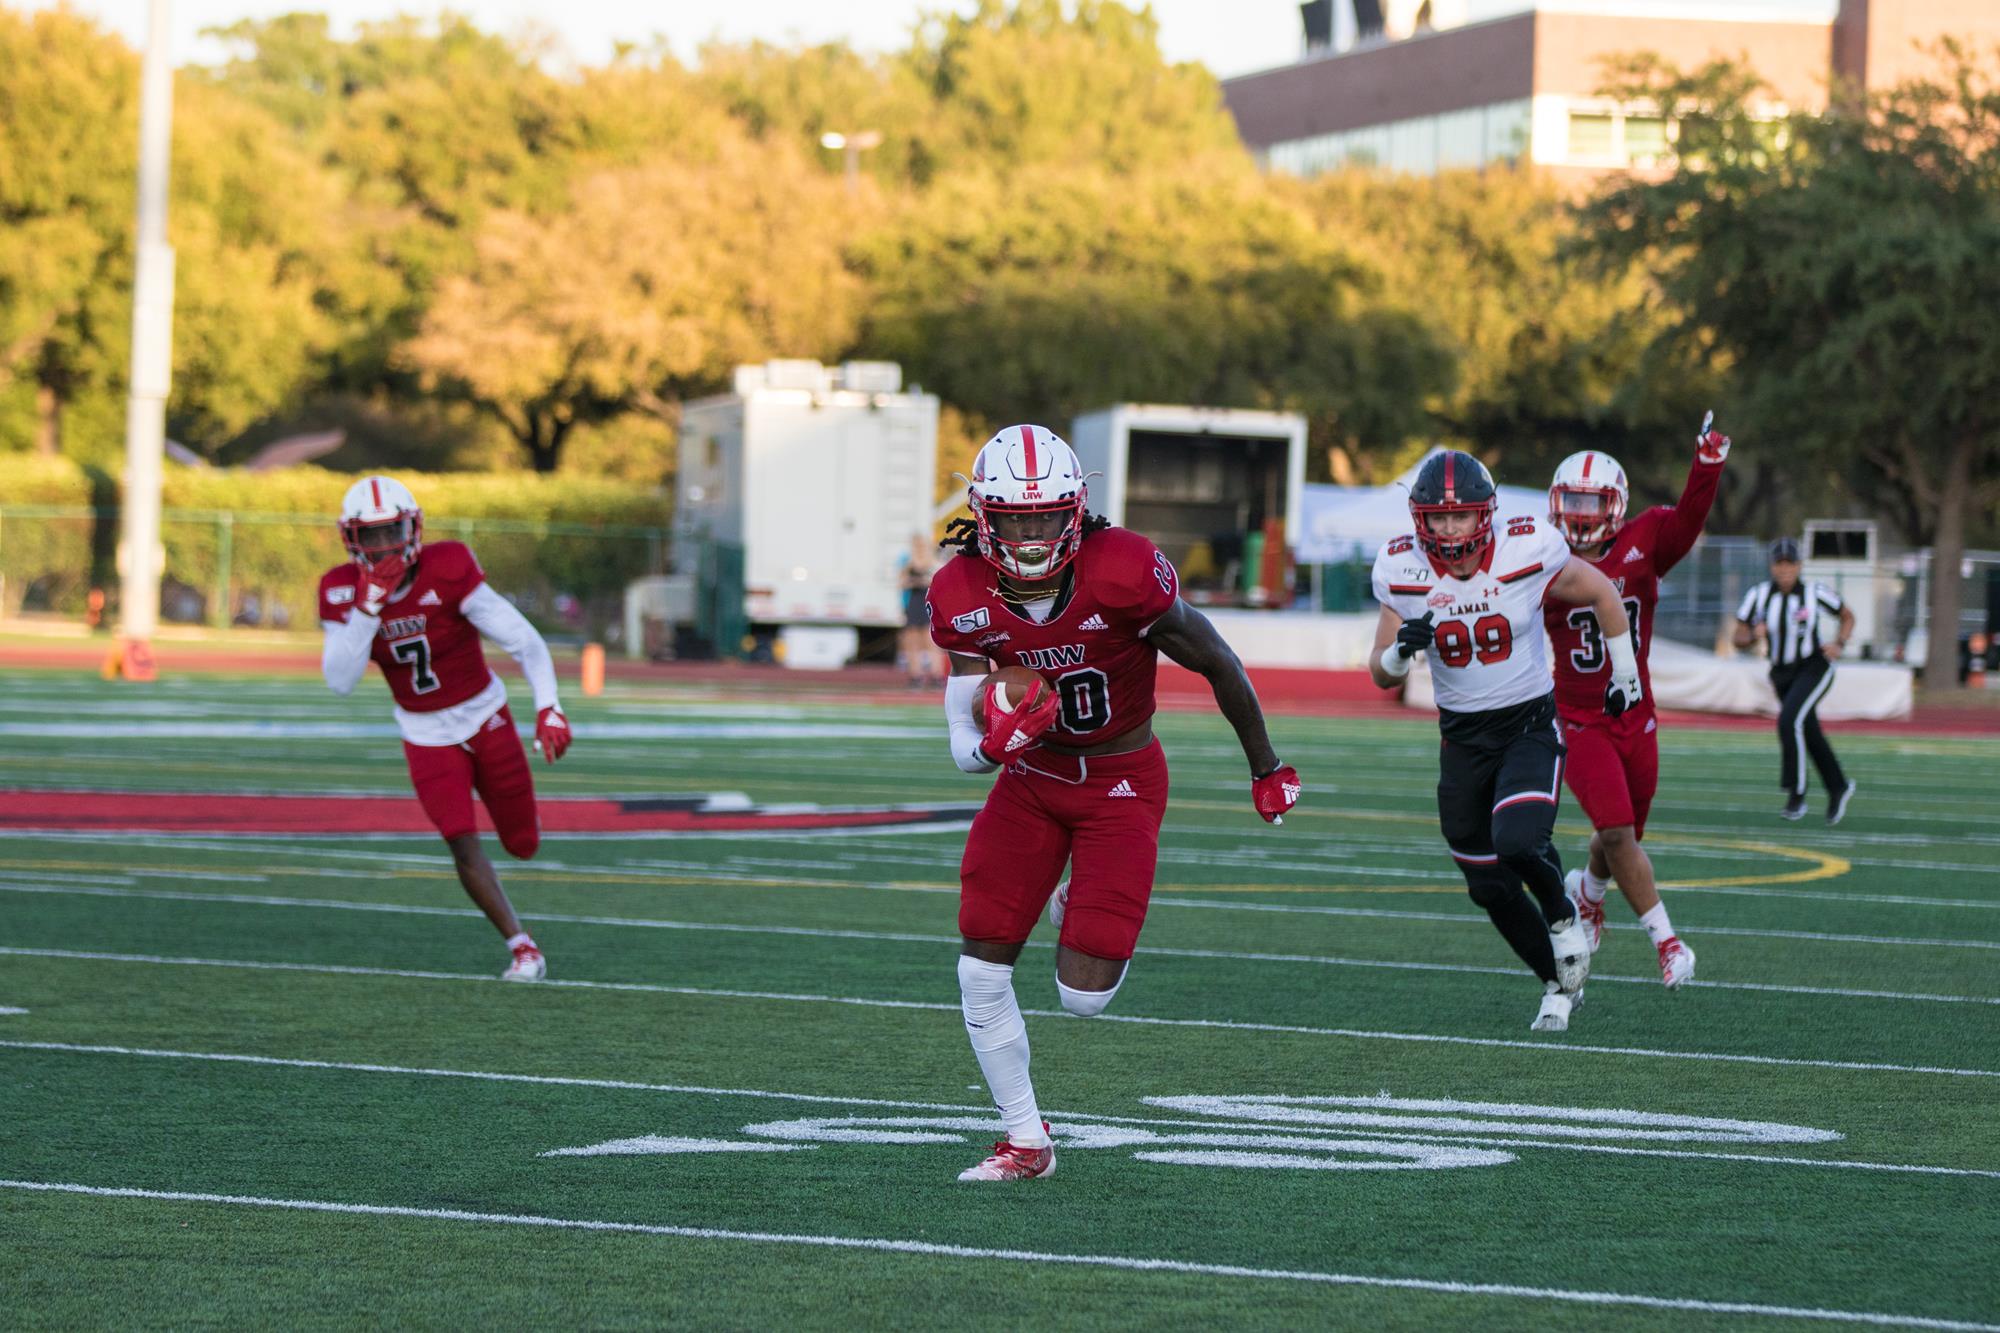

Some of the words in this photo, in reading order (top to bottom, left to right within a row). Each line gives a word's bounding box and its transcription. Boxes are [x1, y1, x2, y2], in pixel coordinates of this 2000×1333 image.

[1022, 491, 1043, 500] UIW
[951, 607, 990, 633] 150
[1449, 602, 1490, 617] LAMAR
[379, 614, 426, 641] UIW
[1078, 623, 1109, 631] adidas
[390, 634, 441, 695] 7
[1016, 644, 1085, 670] UIW
[1046, 667, 1112, 734] 0
